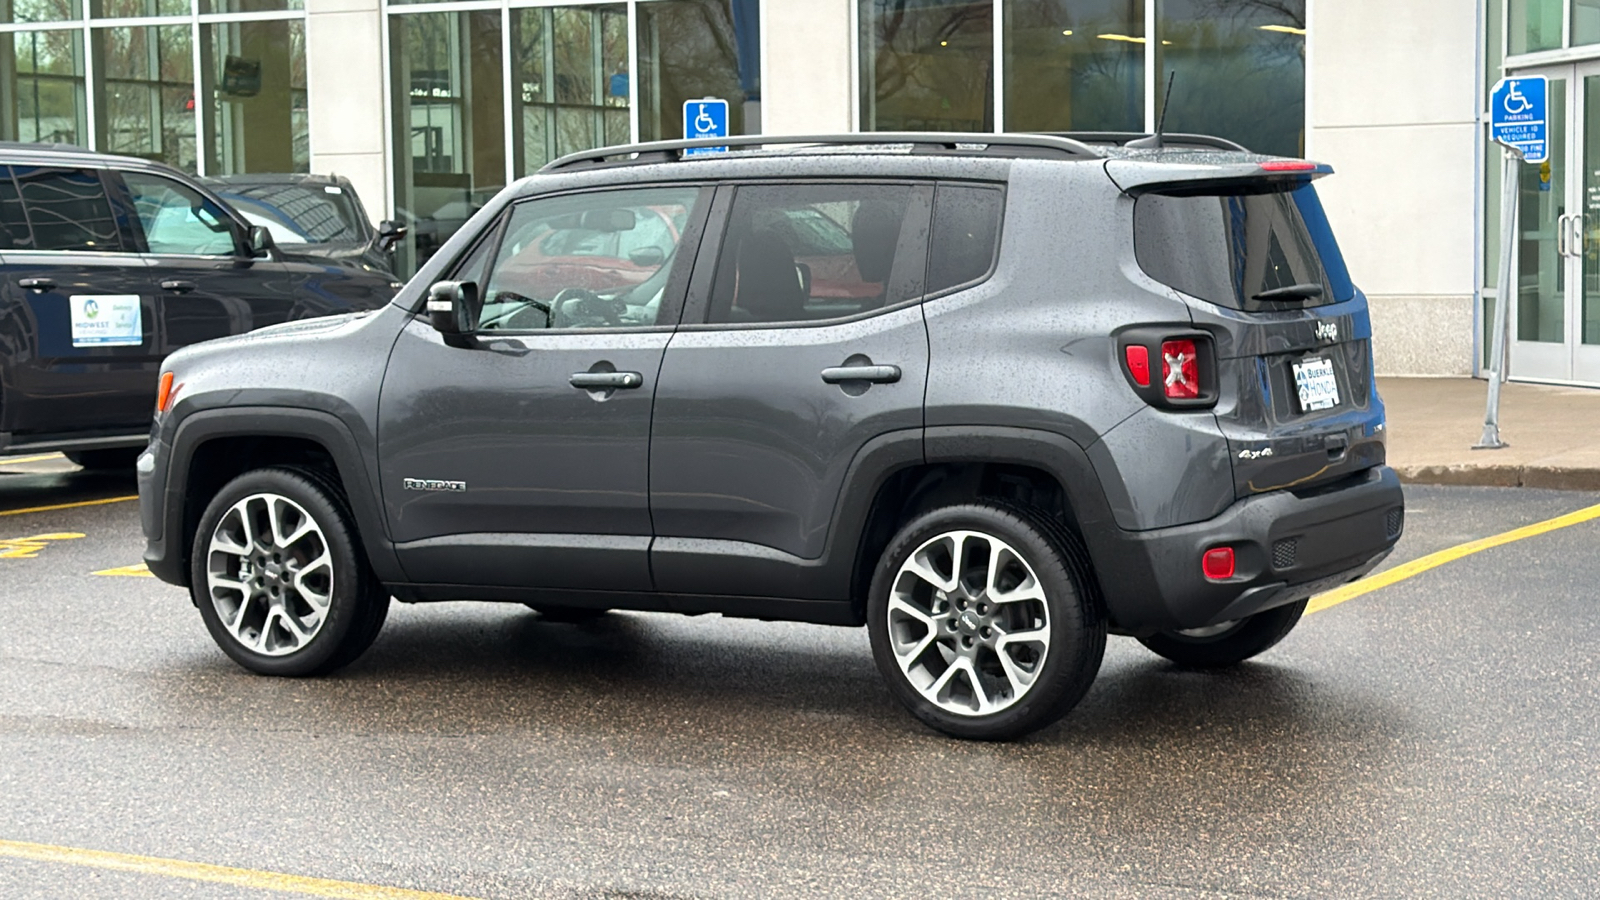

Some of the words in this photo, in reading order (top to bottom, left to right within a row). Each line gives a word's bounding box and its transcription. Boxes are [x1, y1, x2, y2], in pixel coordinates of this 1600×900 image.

[1504, 113, 1533, 121] PARKING
[1500, 126, 1527, 134] VEHICLE
[75, 320, 109, 329] MIDWEST
[1315, 320, 1337, 341] Jeep
[1307, 367, 1333, 379] BUERKLE
[1309, 379, 1336, 397] HONDA
[403, 477, 466, 492] RENEGADE
